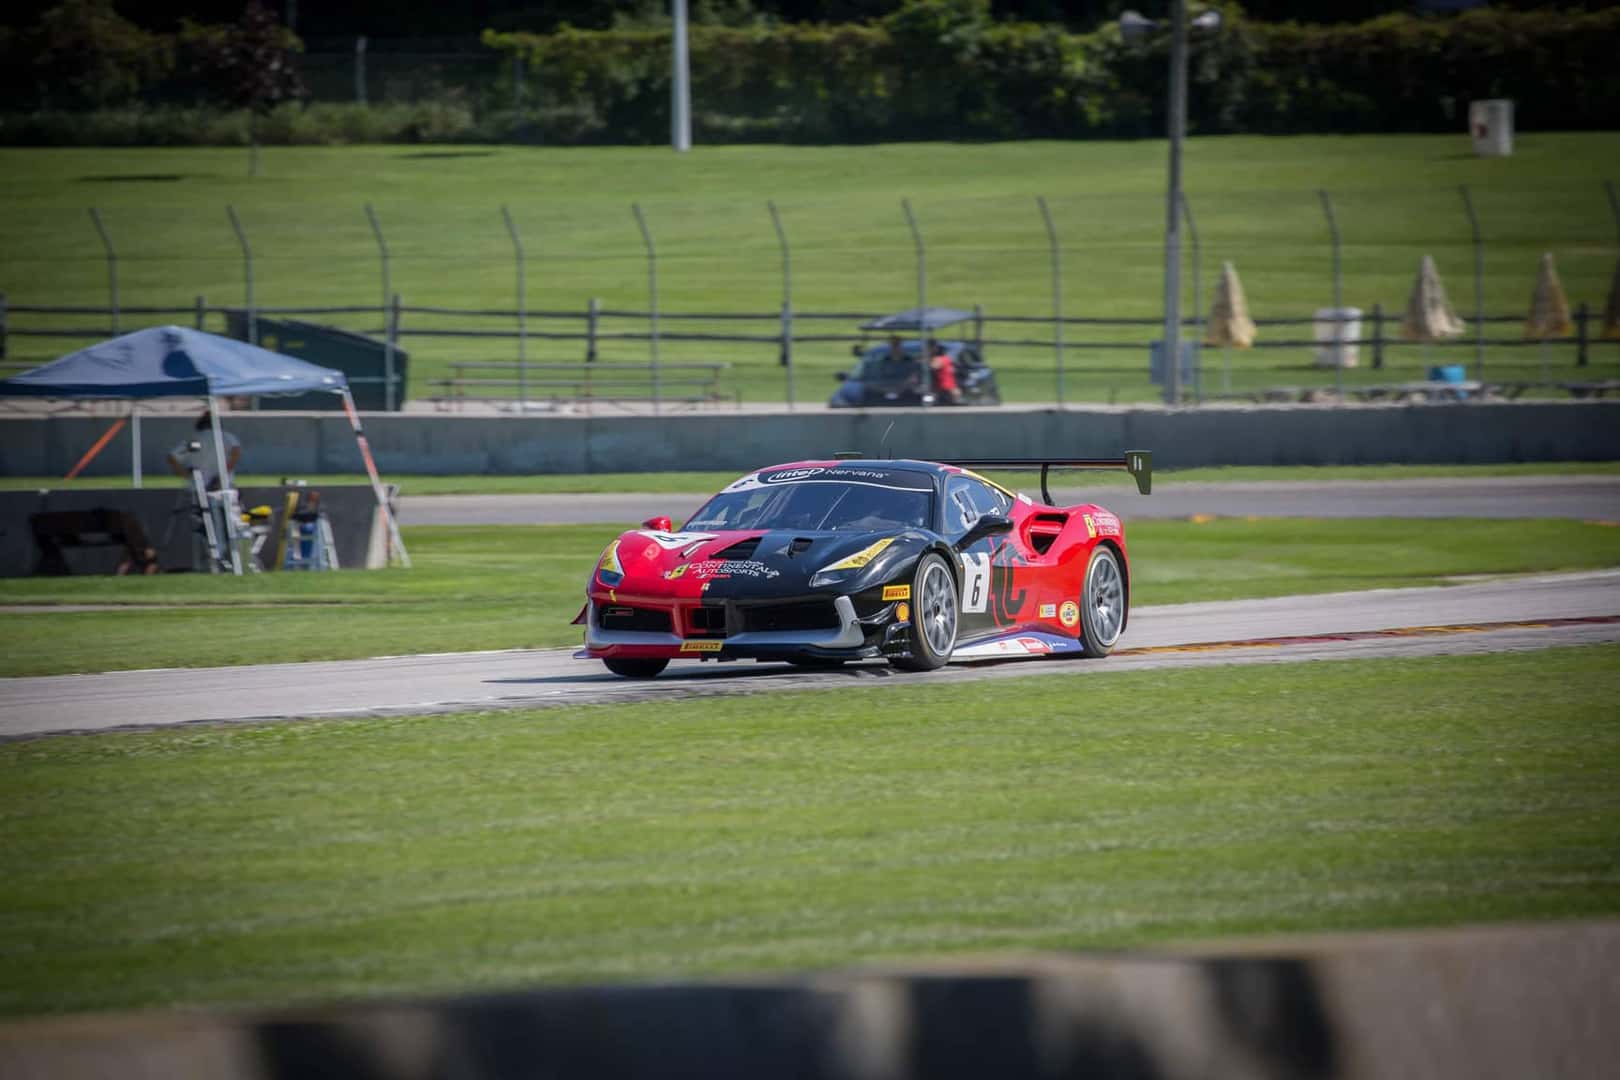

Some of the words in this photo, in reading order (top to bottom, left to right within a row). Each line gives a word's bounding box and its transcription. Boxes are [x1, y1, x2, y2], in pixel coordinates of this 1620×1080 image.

[769, 467, 823, 481] intel
[689, 562, 769, 573] CONTINENTAL
[693, 568, 760, 577] AUTOSPORTS
[971, 574, 982, 607] 6
